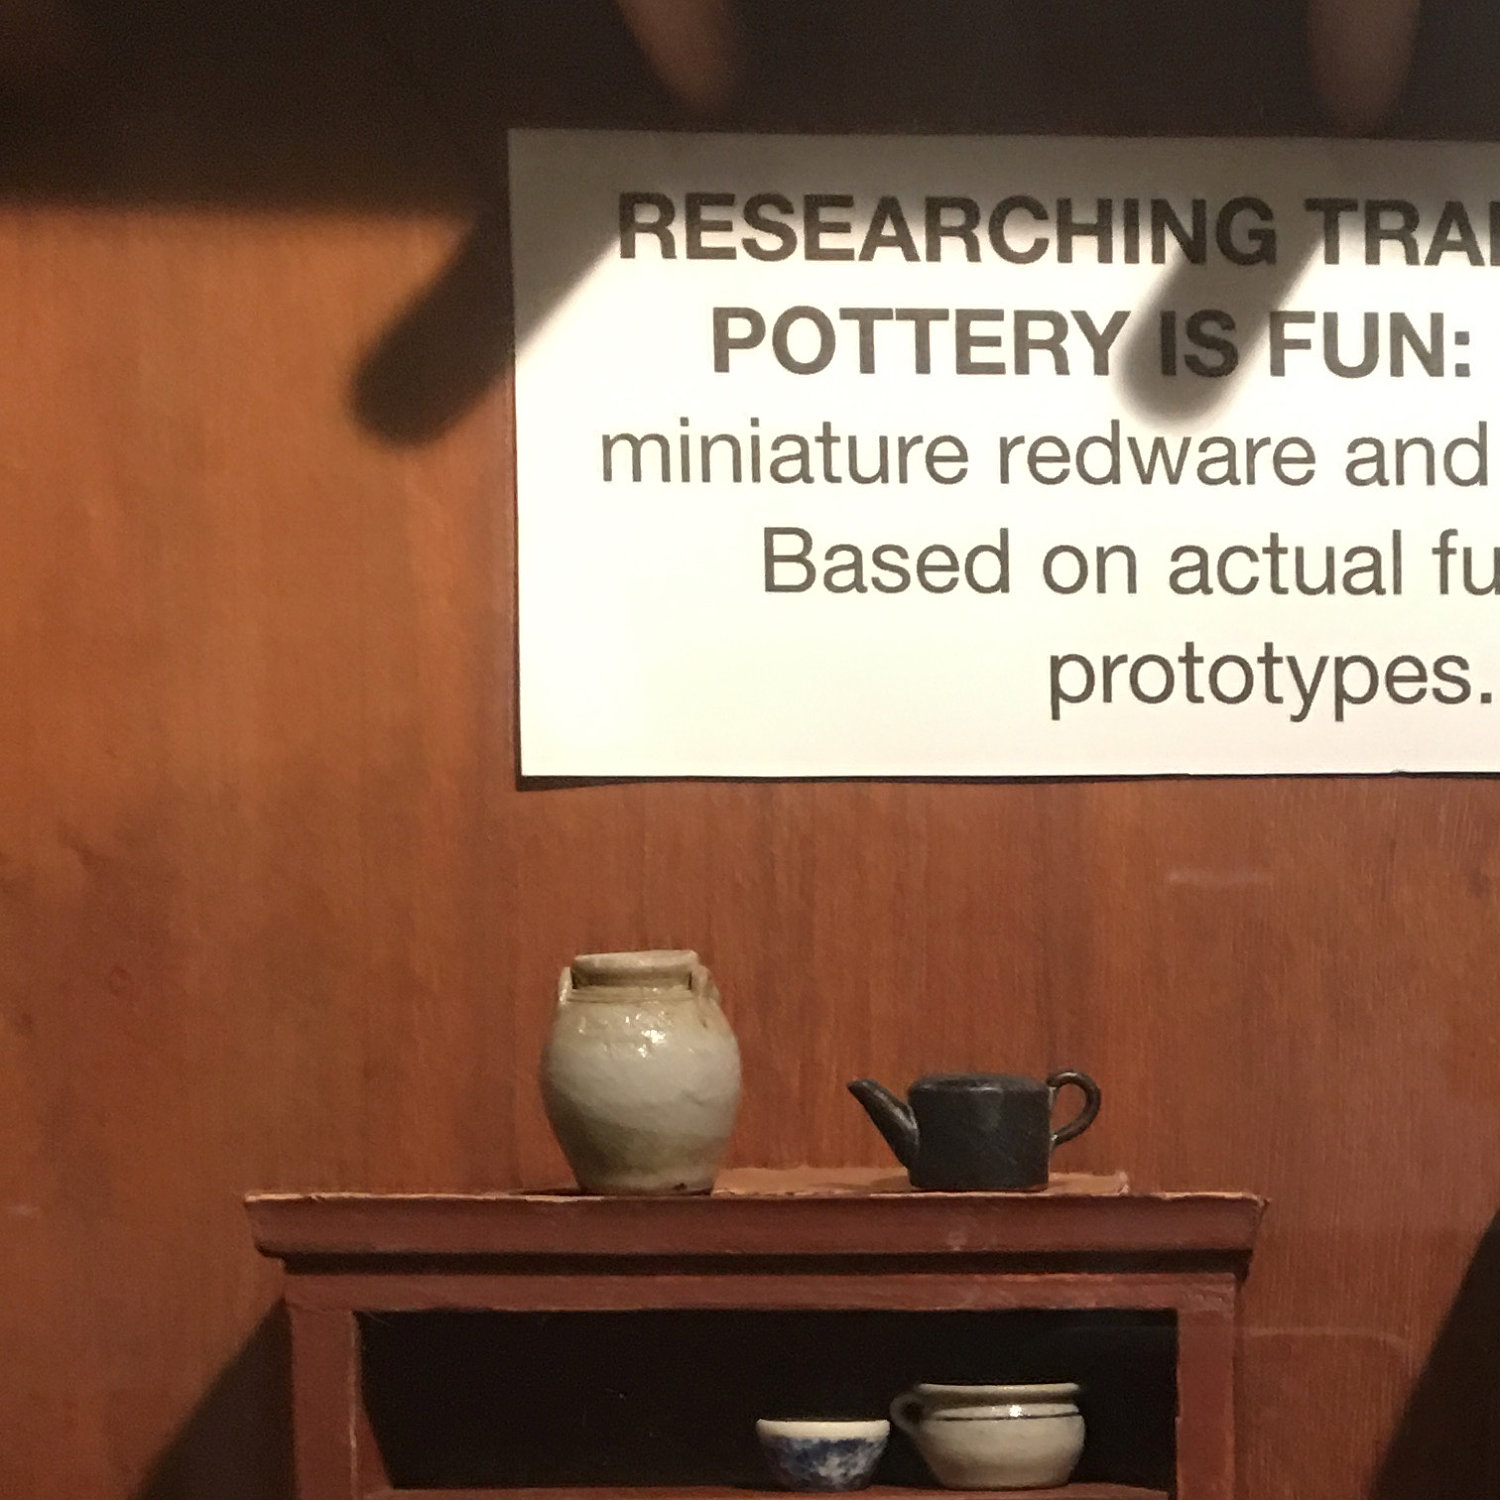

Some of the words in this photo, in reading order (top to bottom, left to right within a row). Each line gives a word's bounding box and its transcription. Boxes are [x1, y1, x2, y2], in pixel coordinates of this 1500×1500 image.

[619, 193, 1277, 269] RESEARCHING
[711, 304, 1133, 377] POTTERY
[1160, 309, 1239, 379] IS
[1267, 309, 1474, 380] FUN:
[600, 416, 971, 487] miniature
[998, 418, 1318, 488] redware
[1343, 420, 1490, 488] and
[762, 526, 1012, 596] Based
[1041, 543, 1139, 597] on
[1167, 527, 1404, 598] actual
[1048, 639, 1494, 725] prototypes.
